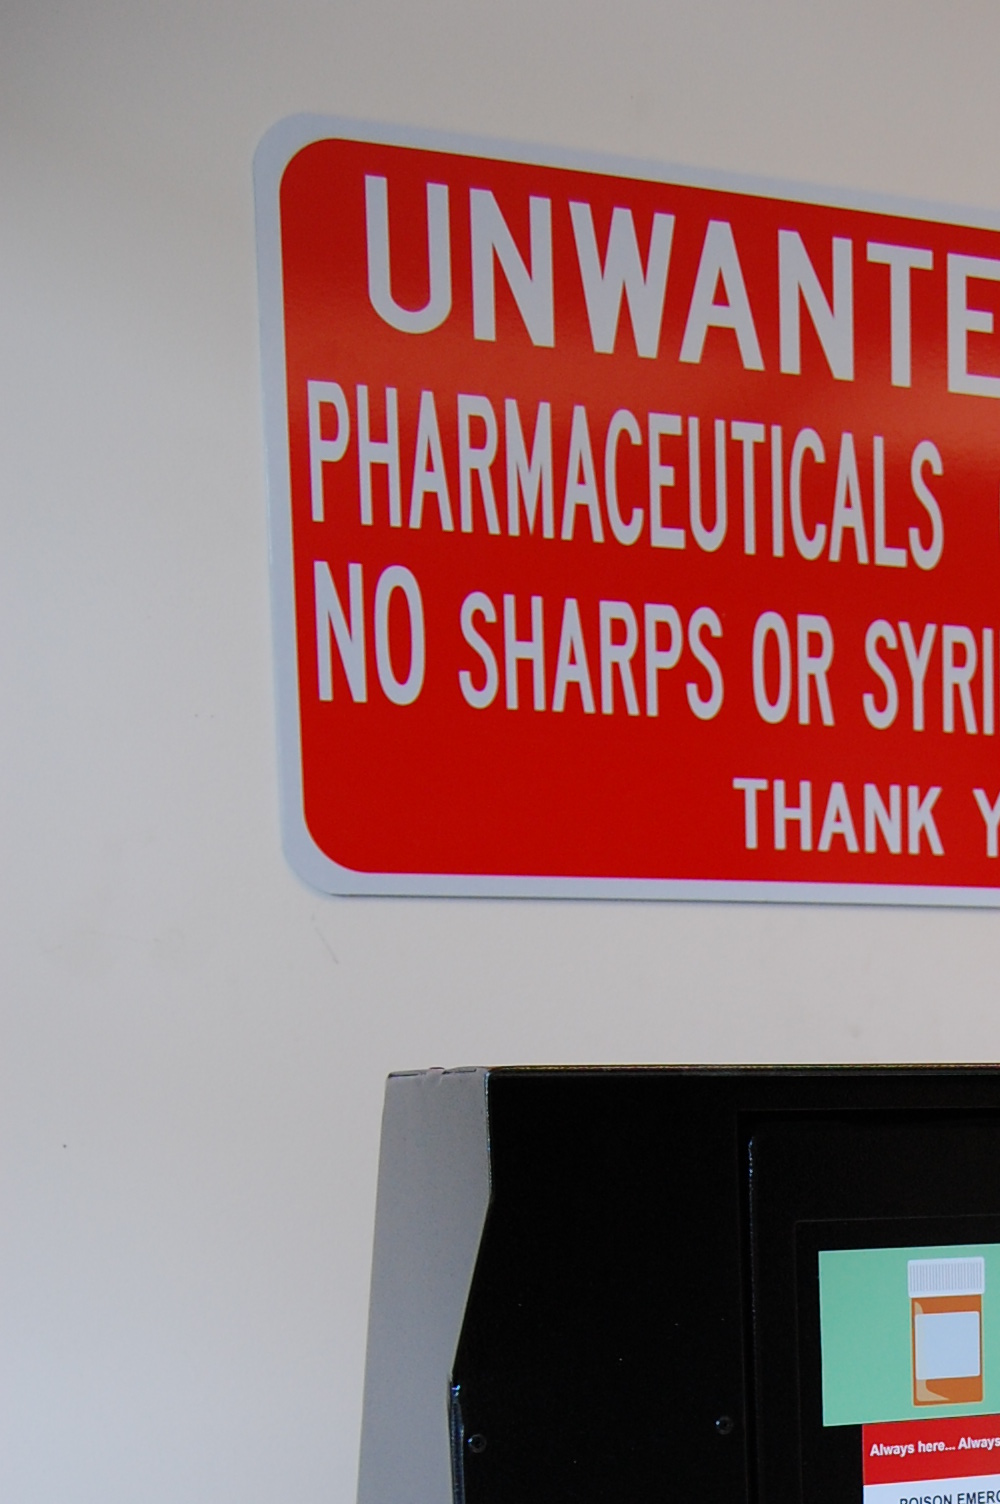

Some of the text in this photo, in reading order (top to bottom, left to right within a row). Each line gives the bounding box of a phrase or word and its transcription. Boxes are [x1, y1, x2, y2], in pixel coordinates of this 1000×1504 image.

[306, 379, 945, 571] PHARMACEUTICALS
[313, 560, 426, 705] NO
[457, 591, 724, 720] SHARPS
[751, 611, 835, 726] OR
[732, 778, 945, 856] THANK
[870, 1441, 915, 1458] Always
[917, 1439, 956, 1453] here...
